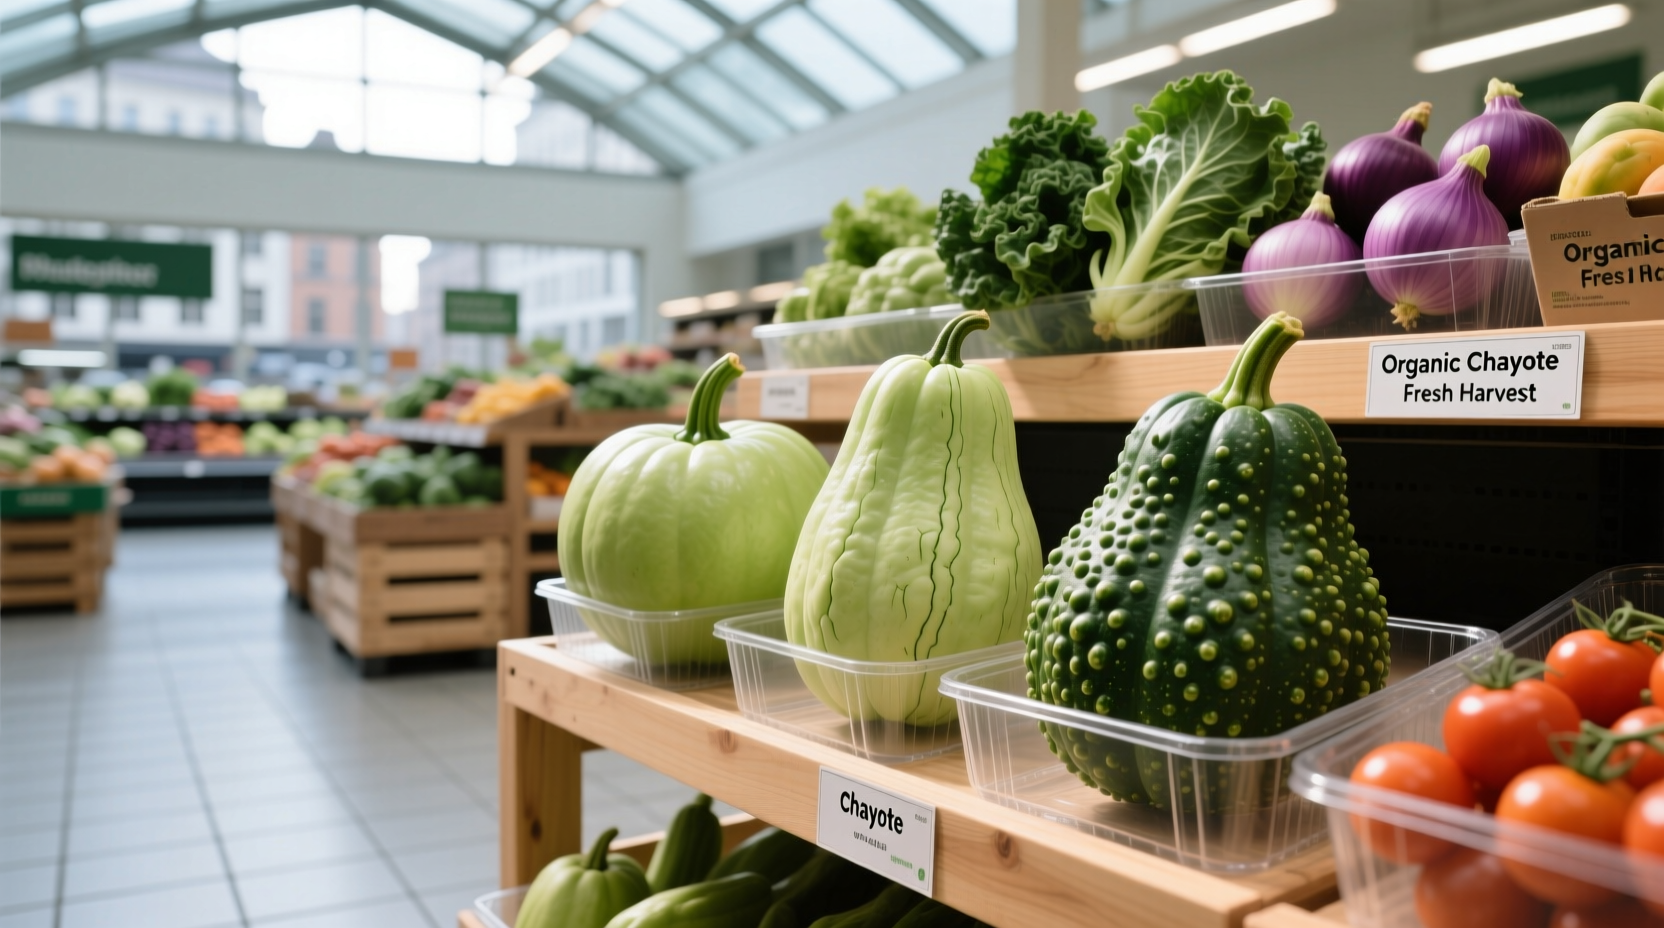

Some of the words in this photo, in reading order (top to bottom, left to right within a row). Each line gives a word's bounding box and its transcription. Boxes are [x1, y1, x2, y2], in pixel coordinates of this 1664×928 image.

[1382, 352, 1460, 379] Organic
[1467, 351, 1559, 377] Chayote
[1404, 384, 1453, 402] Fresh
[1460, 383, 1537, 403] Harvest
[840, 791, 903, 835] Chayote
